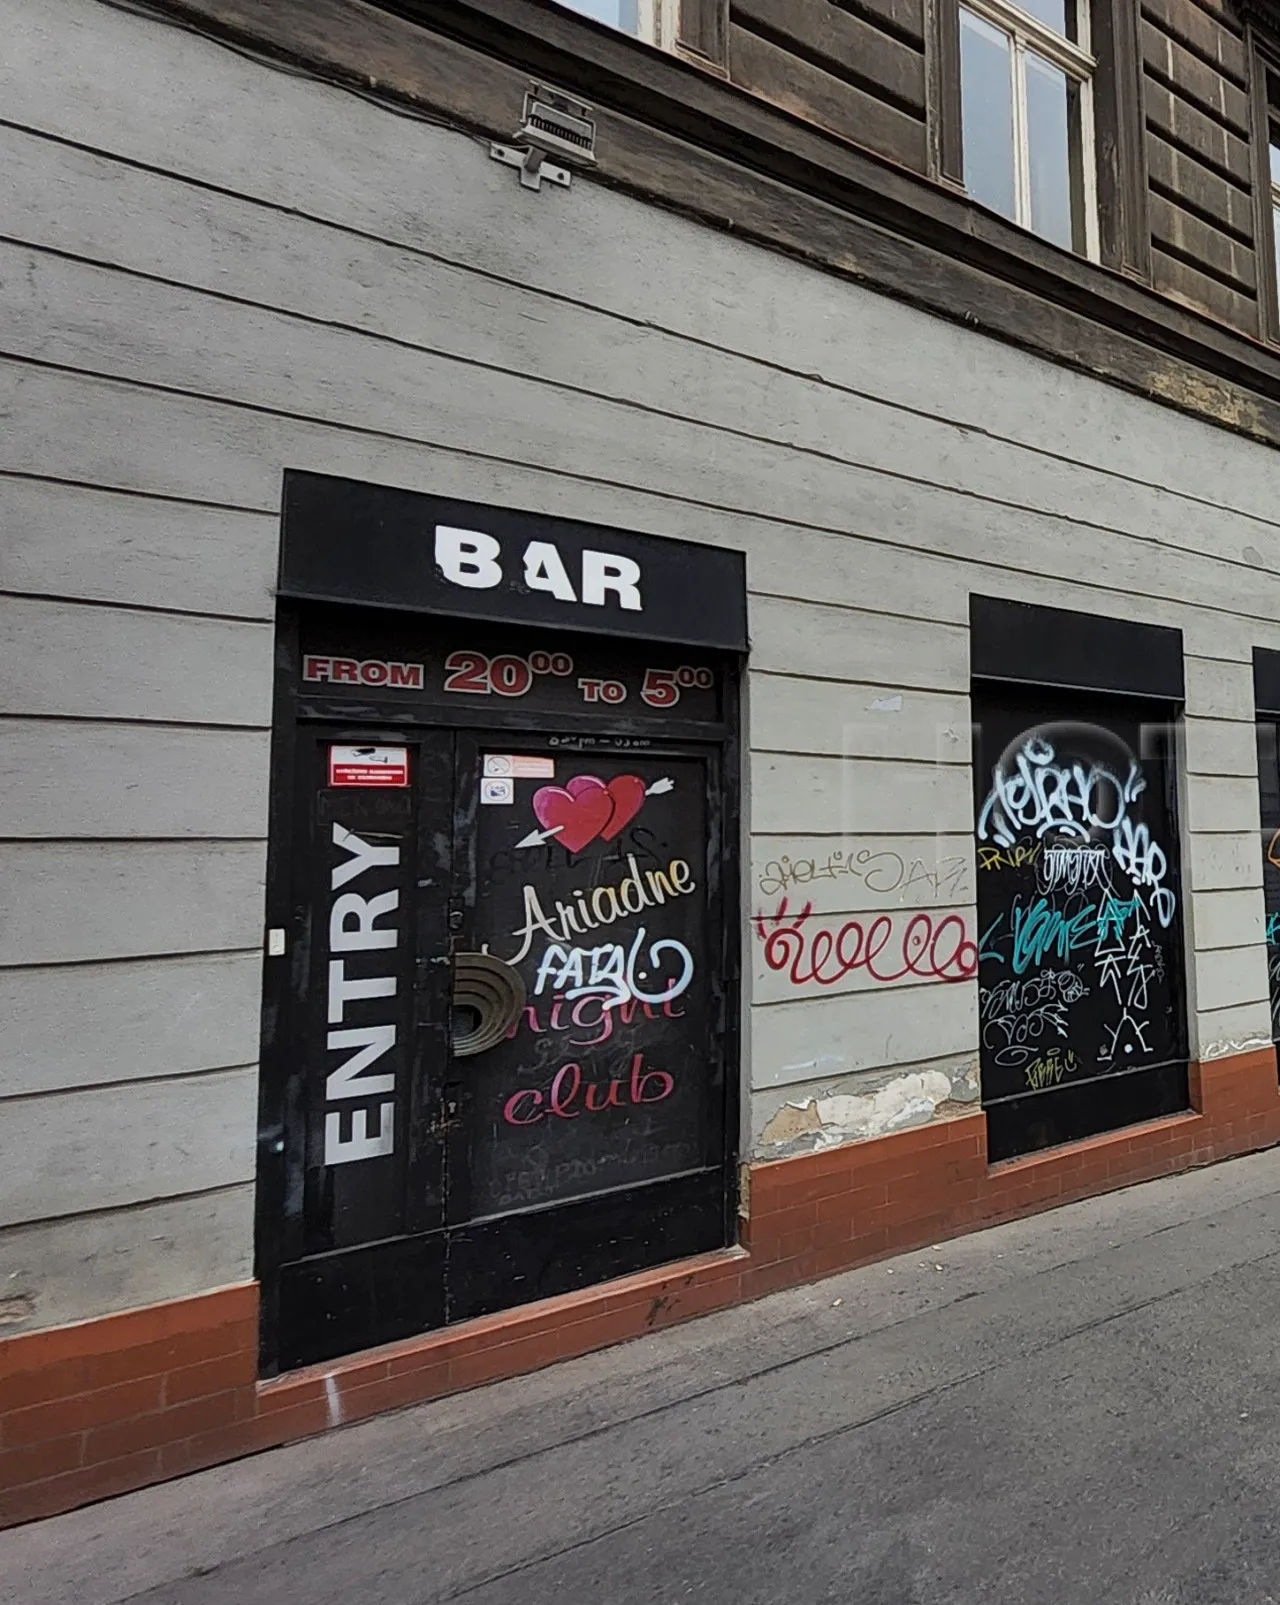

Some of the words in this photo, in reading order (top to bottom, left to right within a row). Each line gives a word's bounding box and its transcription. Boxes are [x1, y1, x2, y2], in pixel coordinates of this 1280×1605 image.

[434, 524, 643, 611] BAR
[302, 653, 425, 690] FROM
[577, 677, 627, 704] TO
[505, 853, 696, 966] Ariadne
[325, 822, 400, 1166] ENTRY
[503, 1053, 675, 1127] club
